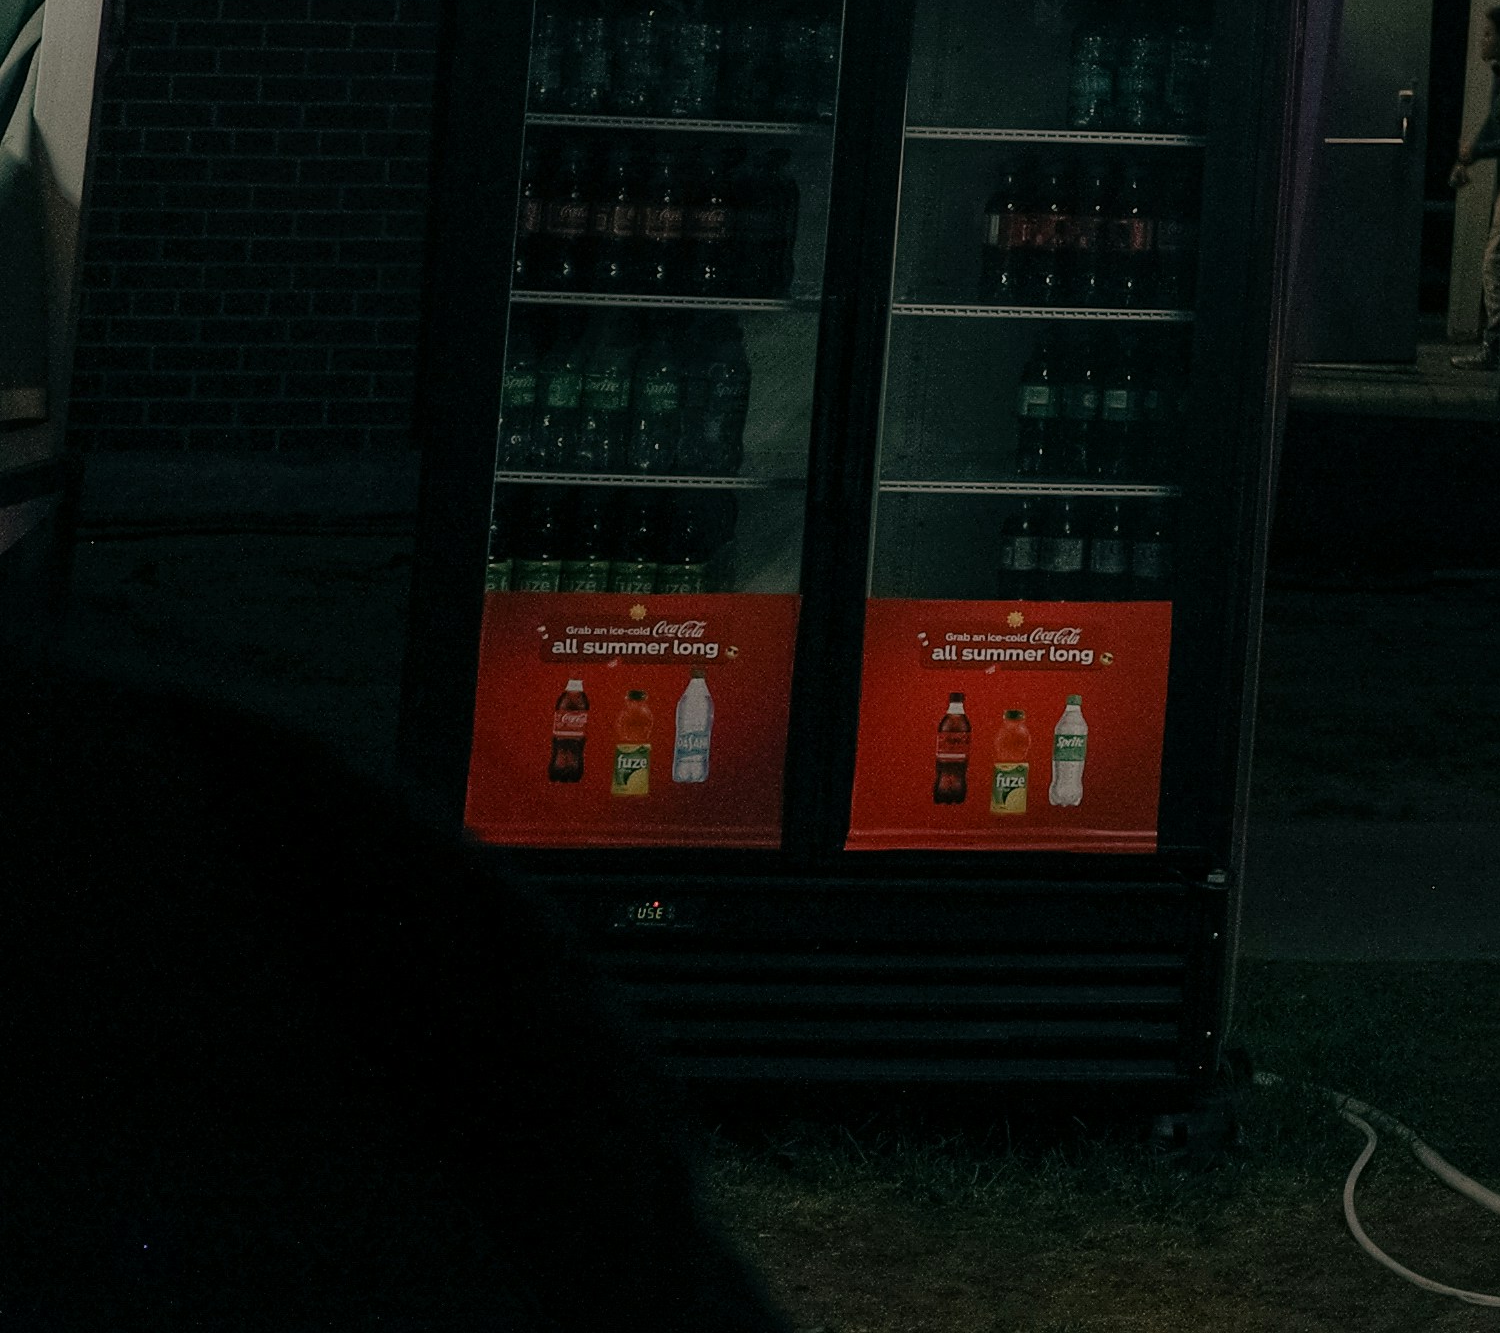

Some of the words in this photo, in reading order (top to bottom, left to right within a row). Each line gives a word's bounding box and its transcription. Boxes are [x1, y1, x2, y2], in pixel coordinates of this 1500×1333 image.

[566, 625, 592, 636] Grab
[593, 626, 608, 636] an
[945, 632, 971, 644] Grab
[972, 633, 986, 643] an
[551, 638, 578, 655] all
[582, 639, 670, 655] summer
[672, 639, 719, 660] long
[931, 644, 958, 661] all
[961, 646, 1046, 663] summer
[1048, 646, 1094, 666] long
